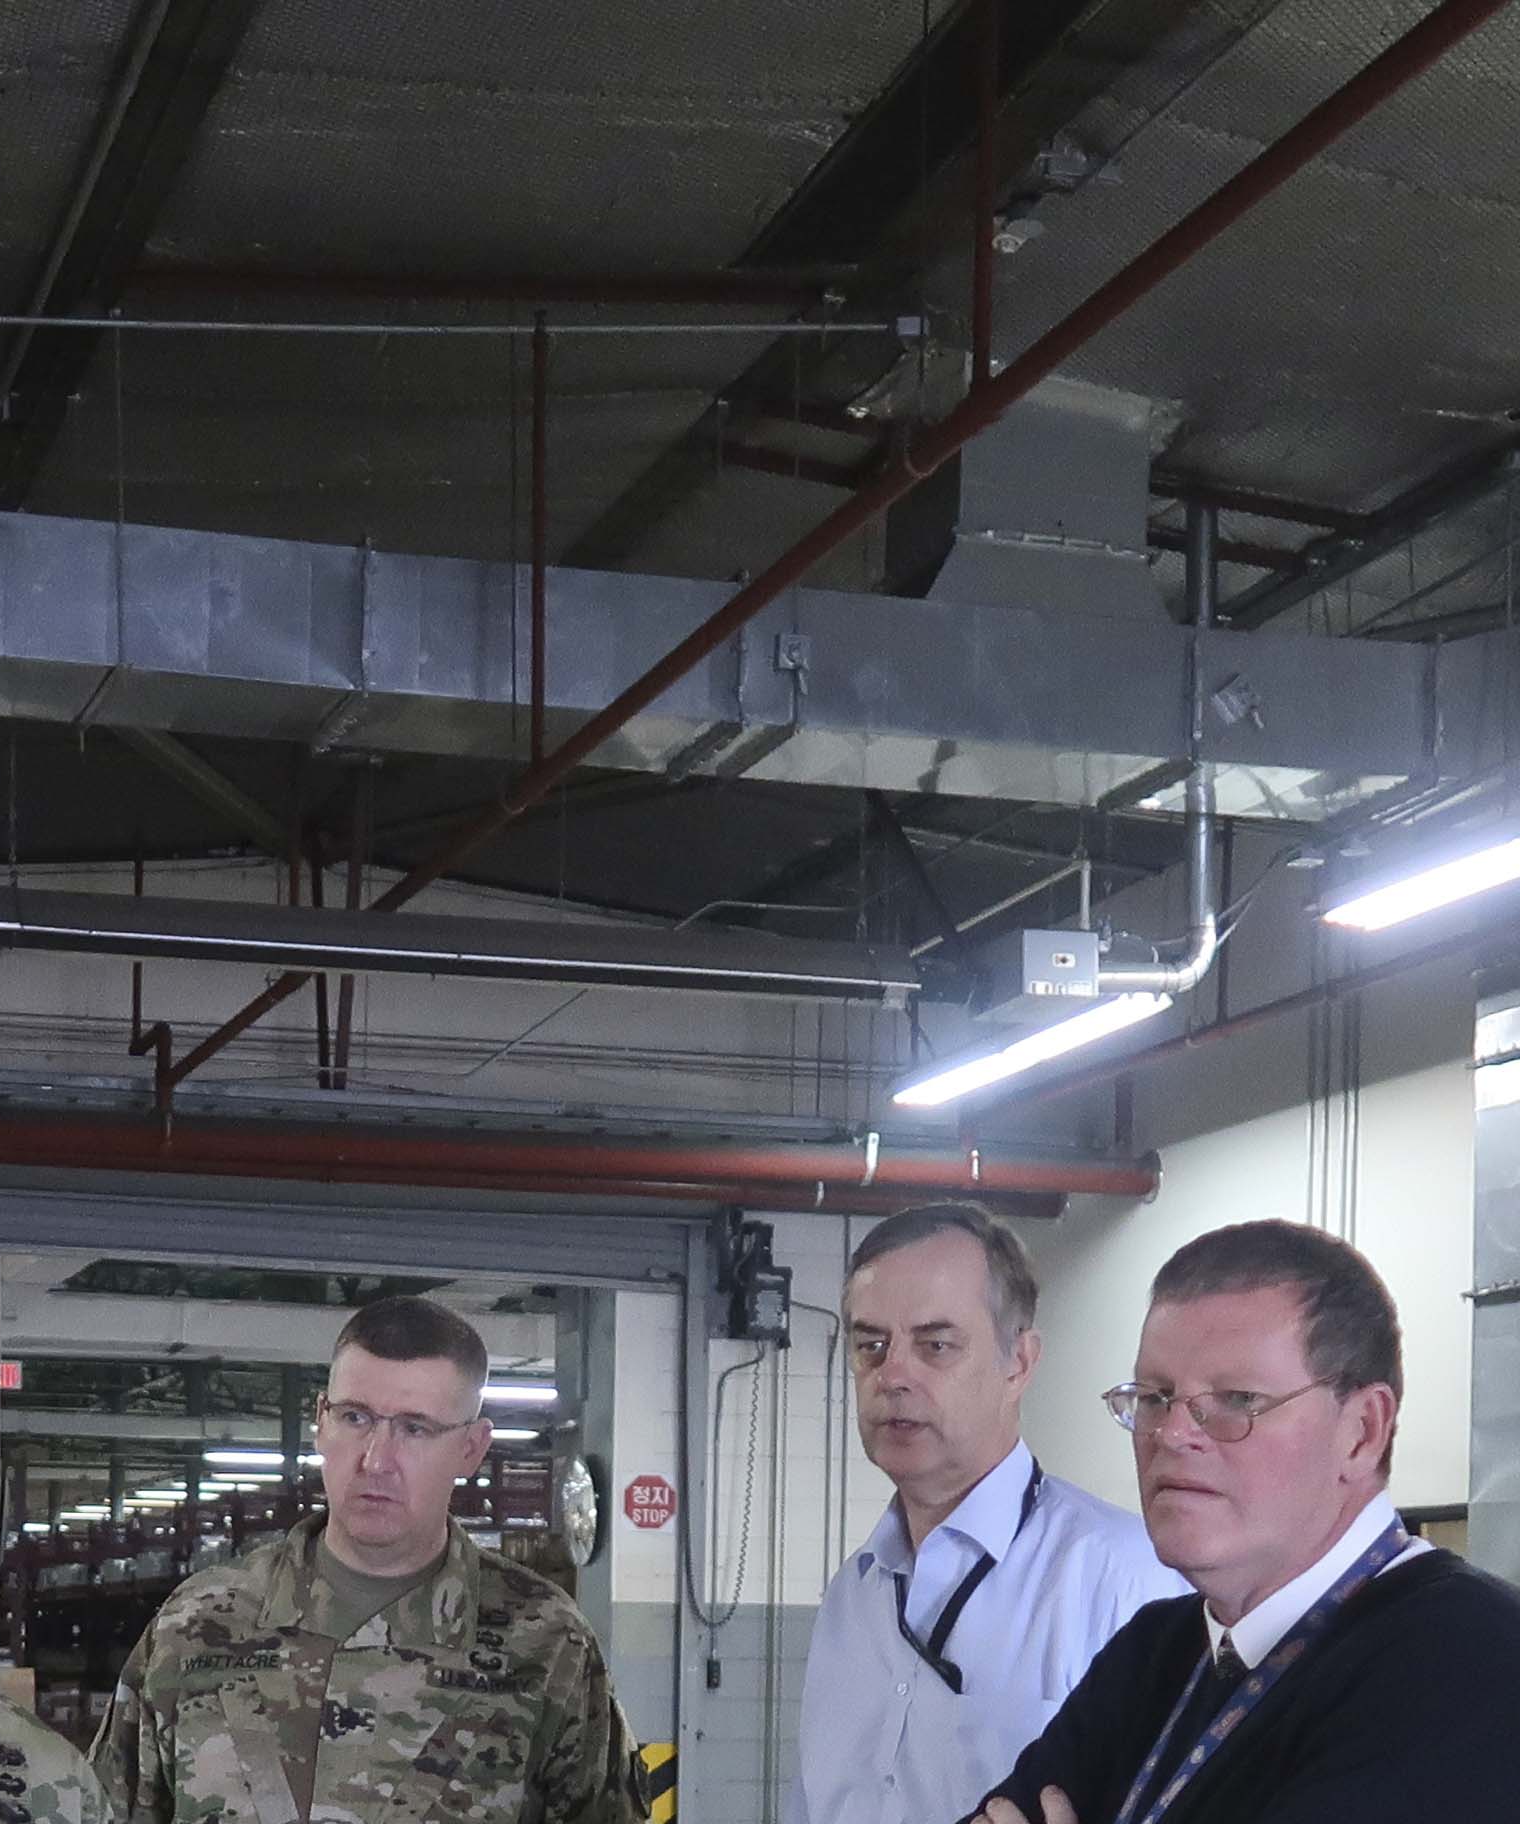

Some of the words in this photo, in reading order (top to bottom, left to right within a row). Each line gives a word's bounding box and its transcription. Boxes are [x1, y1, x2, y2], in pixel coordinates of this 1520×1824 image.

[632, 1485, 670, 1505] 정지
[632, 1507, 669, 1523] STOP
[183, 1654, 280, 1672] WHITTACRE
